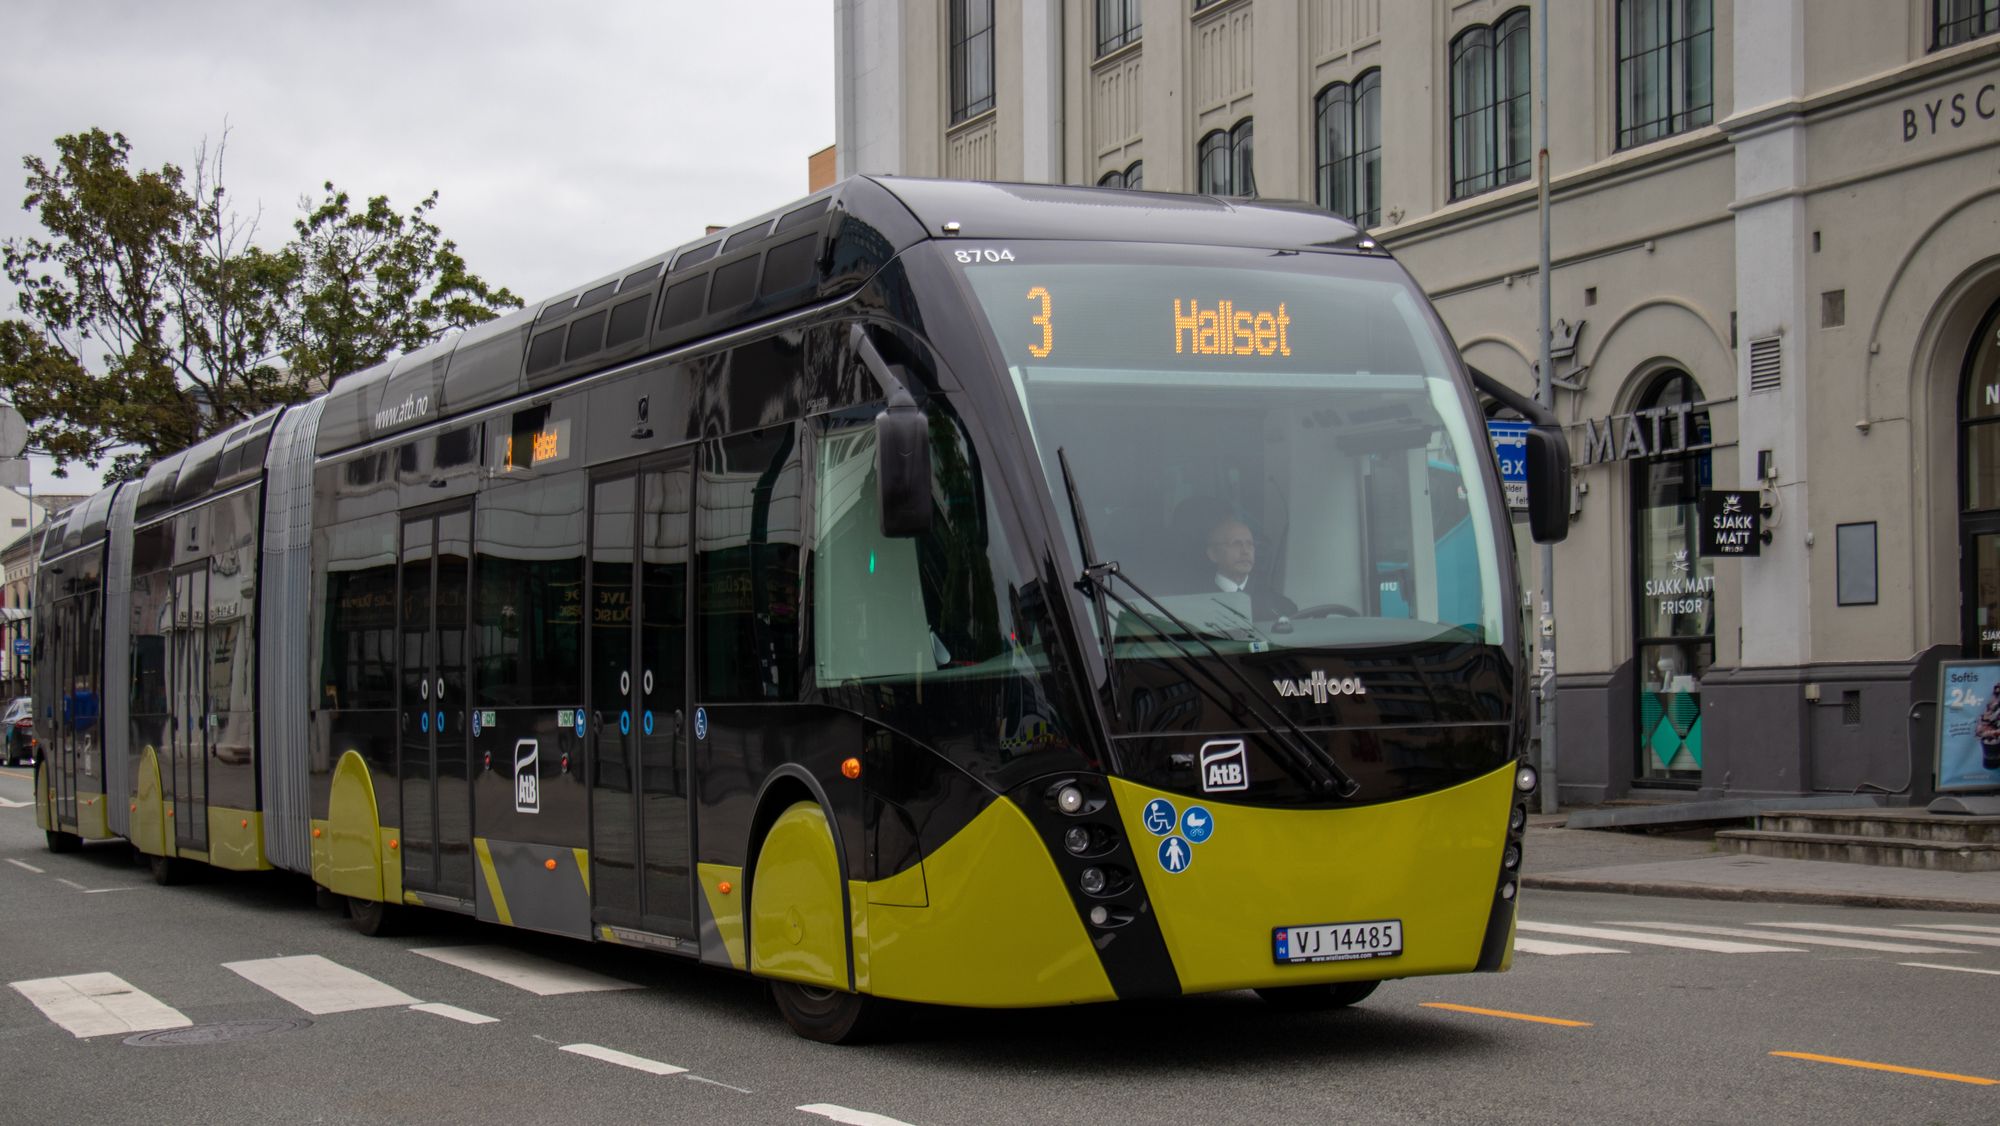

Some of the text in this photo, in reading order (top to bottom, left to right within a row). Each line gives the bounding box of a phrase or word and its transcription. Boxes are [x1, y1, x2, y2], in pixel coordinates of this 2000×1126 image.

[1903, 84, 1996, 143] BYSC
[954, 249, 1015, 264] 8704
[1027, 287, 1291, 358] 3 Hallset
[375, 393, 428, 430] www.atb.no
[1583, 402, 1693, 465] MATT
[1496, 454, 1525, 475] ax
[1503, 484, 1523, 493] elder
[1713, 516, 1753, 529] SJAKK
[1716, 532, 1750, 545] MATT
[1645, 576, 1716, 597] SJAKK MATT
[1661, 599, 1702, 615] FRISØR
[1951, 672, 1979, 683] Softis
[1208, 764, 1242, 786] AtB
[519, 774, 536, 804] AtB
[1296, 925, 1393, 953] VJ 14485
